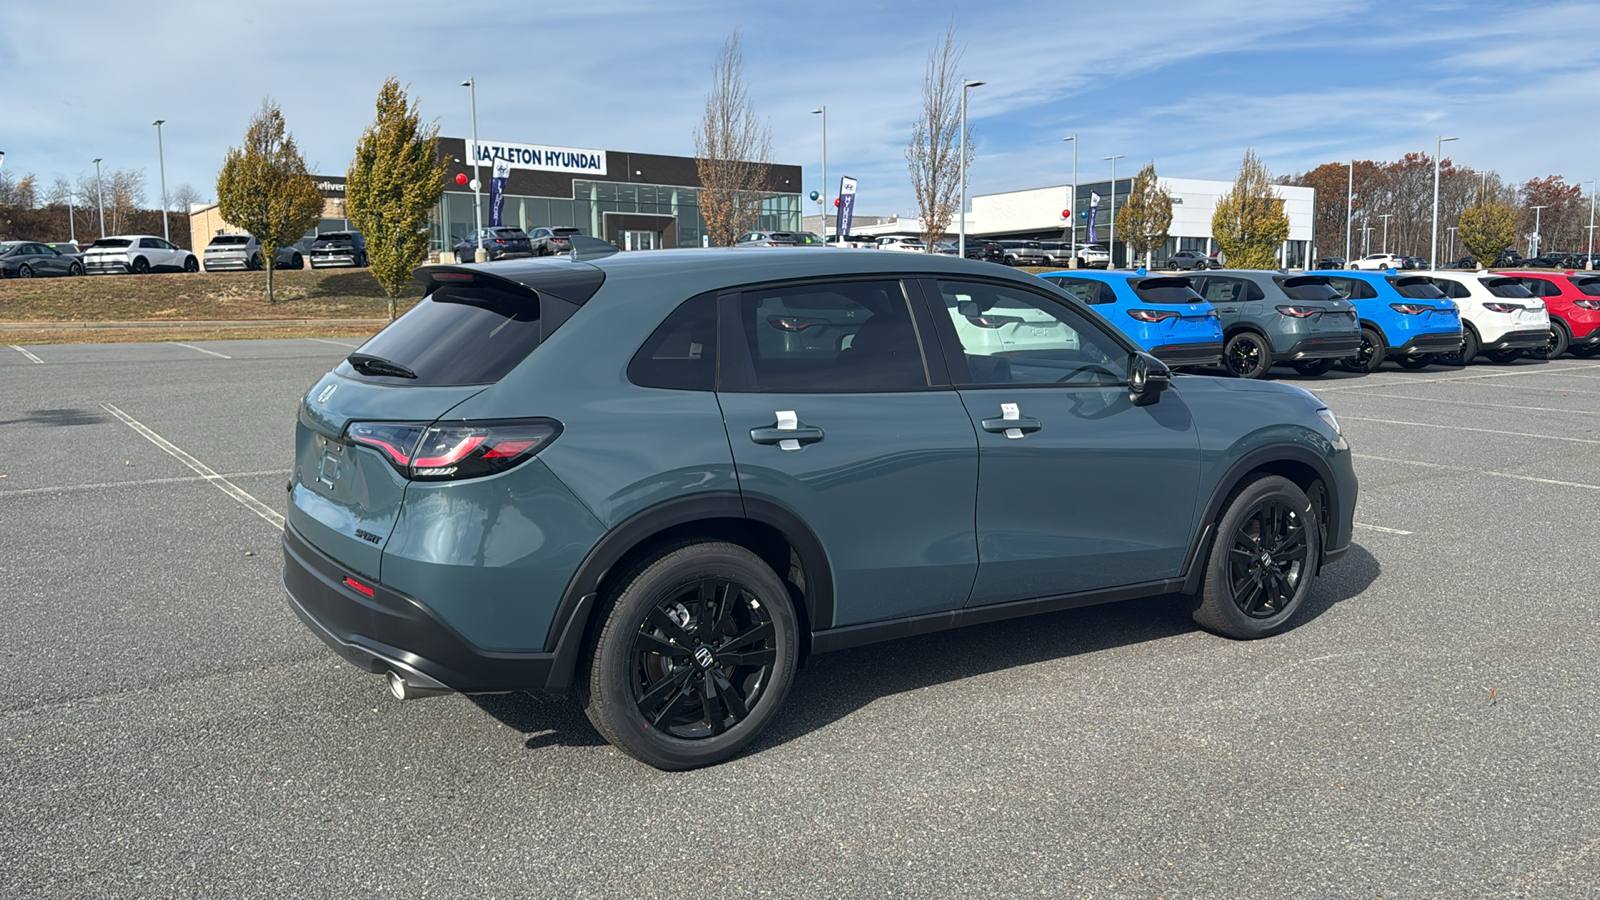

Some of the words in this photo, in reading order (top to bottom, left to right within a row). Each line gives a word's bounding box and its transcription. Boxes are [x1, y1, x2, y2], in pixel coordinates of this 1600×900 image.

[545, 151, 601, 169] HYUNDAI
[842, 196, 851, 235] HYUNDAI
[355, 529, 383, 545] SPORT
